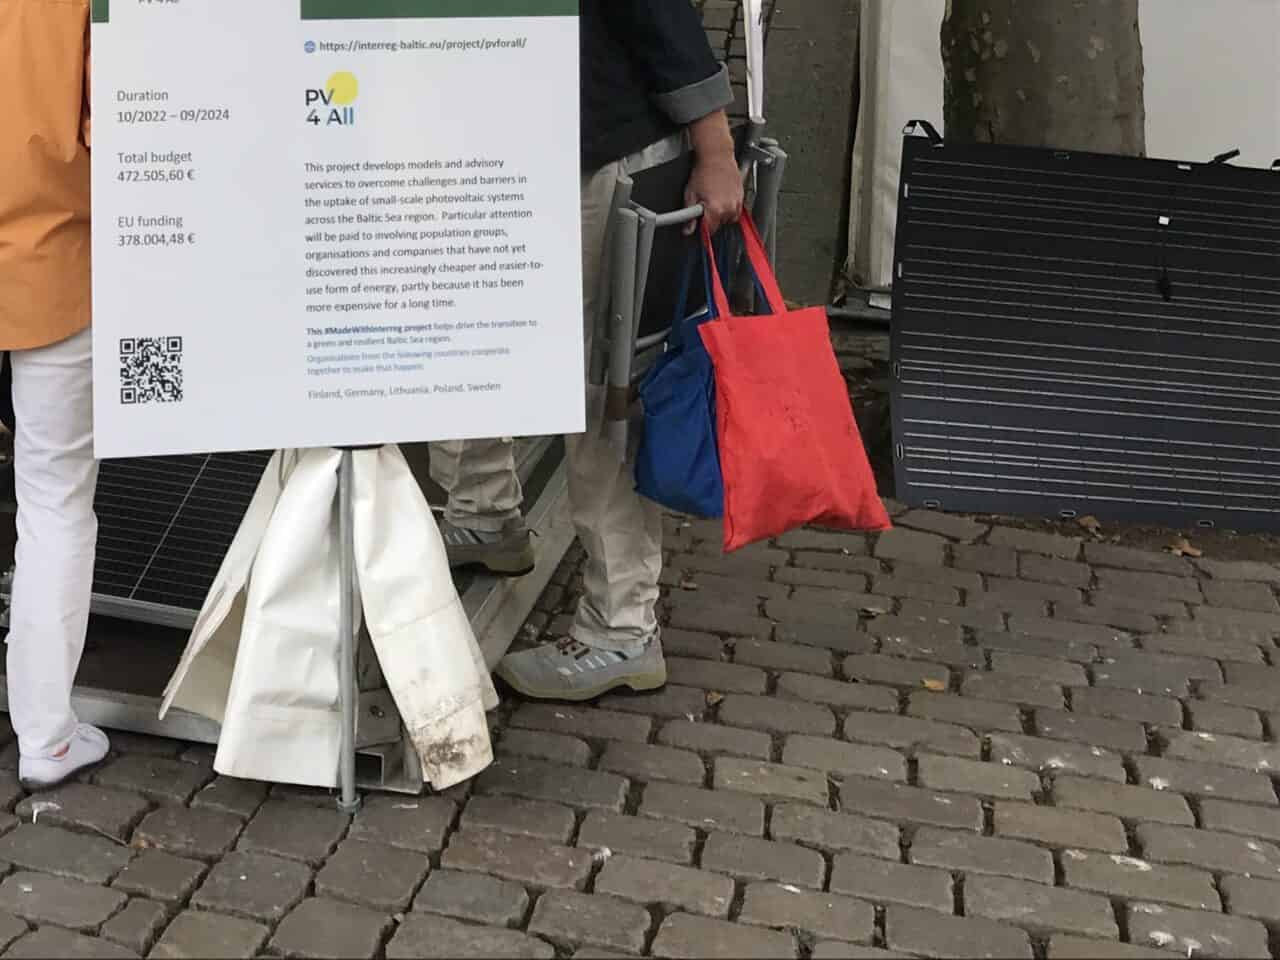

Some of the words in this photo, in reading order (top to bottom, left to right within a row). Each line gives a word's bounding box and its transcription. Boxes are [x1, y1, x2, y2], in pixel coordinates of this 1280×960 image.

[117, 90, 168, 102] Duration
[305, 89, 335, 106] PV
[118, 110, 167, 124] 10/2022
[180, 108, 230, 122] 09/2024
[305, 108, 321, 125] 4
[327, 107, 354, 125] All
[118, 152, 147, 164] Total
[151, 151, 192, 164] budget
[304, 163, 324, 173] This
[326, 162, 360, 173] project
[363, 161, 406, 172] develops
[408, 160, 442, 170] models
[445, 159, 462, 169] and
[465, 159, 504, 169] advisory
[118, 169, 184, 183] 472.505,60
[187, 169, 195, 181] €
[305, 180, 343, 190] services
[345, 180, 355, 189] to
[358, 179, 405, 188] overcome
[408, 177, 457, 188] challenges
[462, 176, 477, 185] and
[480, 175, 515, 185] barriers
[518, 175, 527, 184] in
[305, 198, 320, 208] the
[323, 197, 357, 208] uptake
[359, 196, 369, 206] of
[372, 195, 423, 205] small-scale
[426, 193, 484, 205] photovoltaic
[487, 192, 525, 203] systems
[118, 217, 134, 228] EU
[138, 215, 183, 228] funding
[305, 216, 335, 225] across
[338, 214, 354, 224] the
[357, 213, 383, 223] Baltic
[385, 212, 402, 222] Sea
[405, 213, 435, 224] region.
[442, 210, 487, 220] Particular
[490, 209, 533, 219] attention
[118, 232, 184, 247] 378.004,48
[188, 233, 196, 244] €
[305, 231, 322, 242] will
[325, 231, 337, 241] be
[339, 231, 359, 242] paid
[362, 231, 373, 241] to
[375, 230, 417, 241] involving
[420, 228, 471, 240] population
[473, 228, 508, 239] groups,
[305, 248, 370, 261] organisations
[373, 248, 390, 258] and
[393, 246, 443, 258] companies
[446, 245, 465, 255] that
[468, 244, 491, 254] have
[493, 243, 509, 253] not
[512, 243, 526, 254] yet
[306, 266, 357, 278] discovered
[360, 265, 377, 276] this
[380, 262, 436, 275] increasingly
[439, 262, 476, 274] cheaper
[479, 261, 497, 271] and
[499, 259, 544, 270] easier-to-
[306, 286, 323, 295] use
[325, 284, 349, 295] form
[351, 283, 361, 294] of
[363, 283, 399, 295] energy,
[402, 280, 429, 293] partly
[432, 279, 470, 290] because
[473, 278, 479, 289] it
[482, 278, 498, 288] has
[501, 277, 524, 288] been
[306, 303, 332, 313] more
[334, 302, 382, 313] expensive
[385, 300, 398, 310] for
[401, 301, 407, 309] a
[409, 298, 429, 310] long
[432, 298, 456, 308] time.
[467, 381, 501, 392] Sweden
